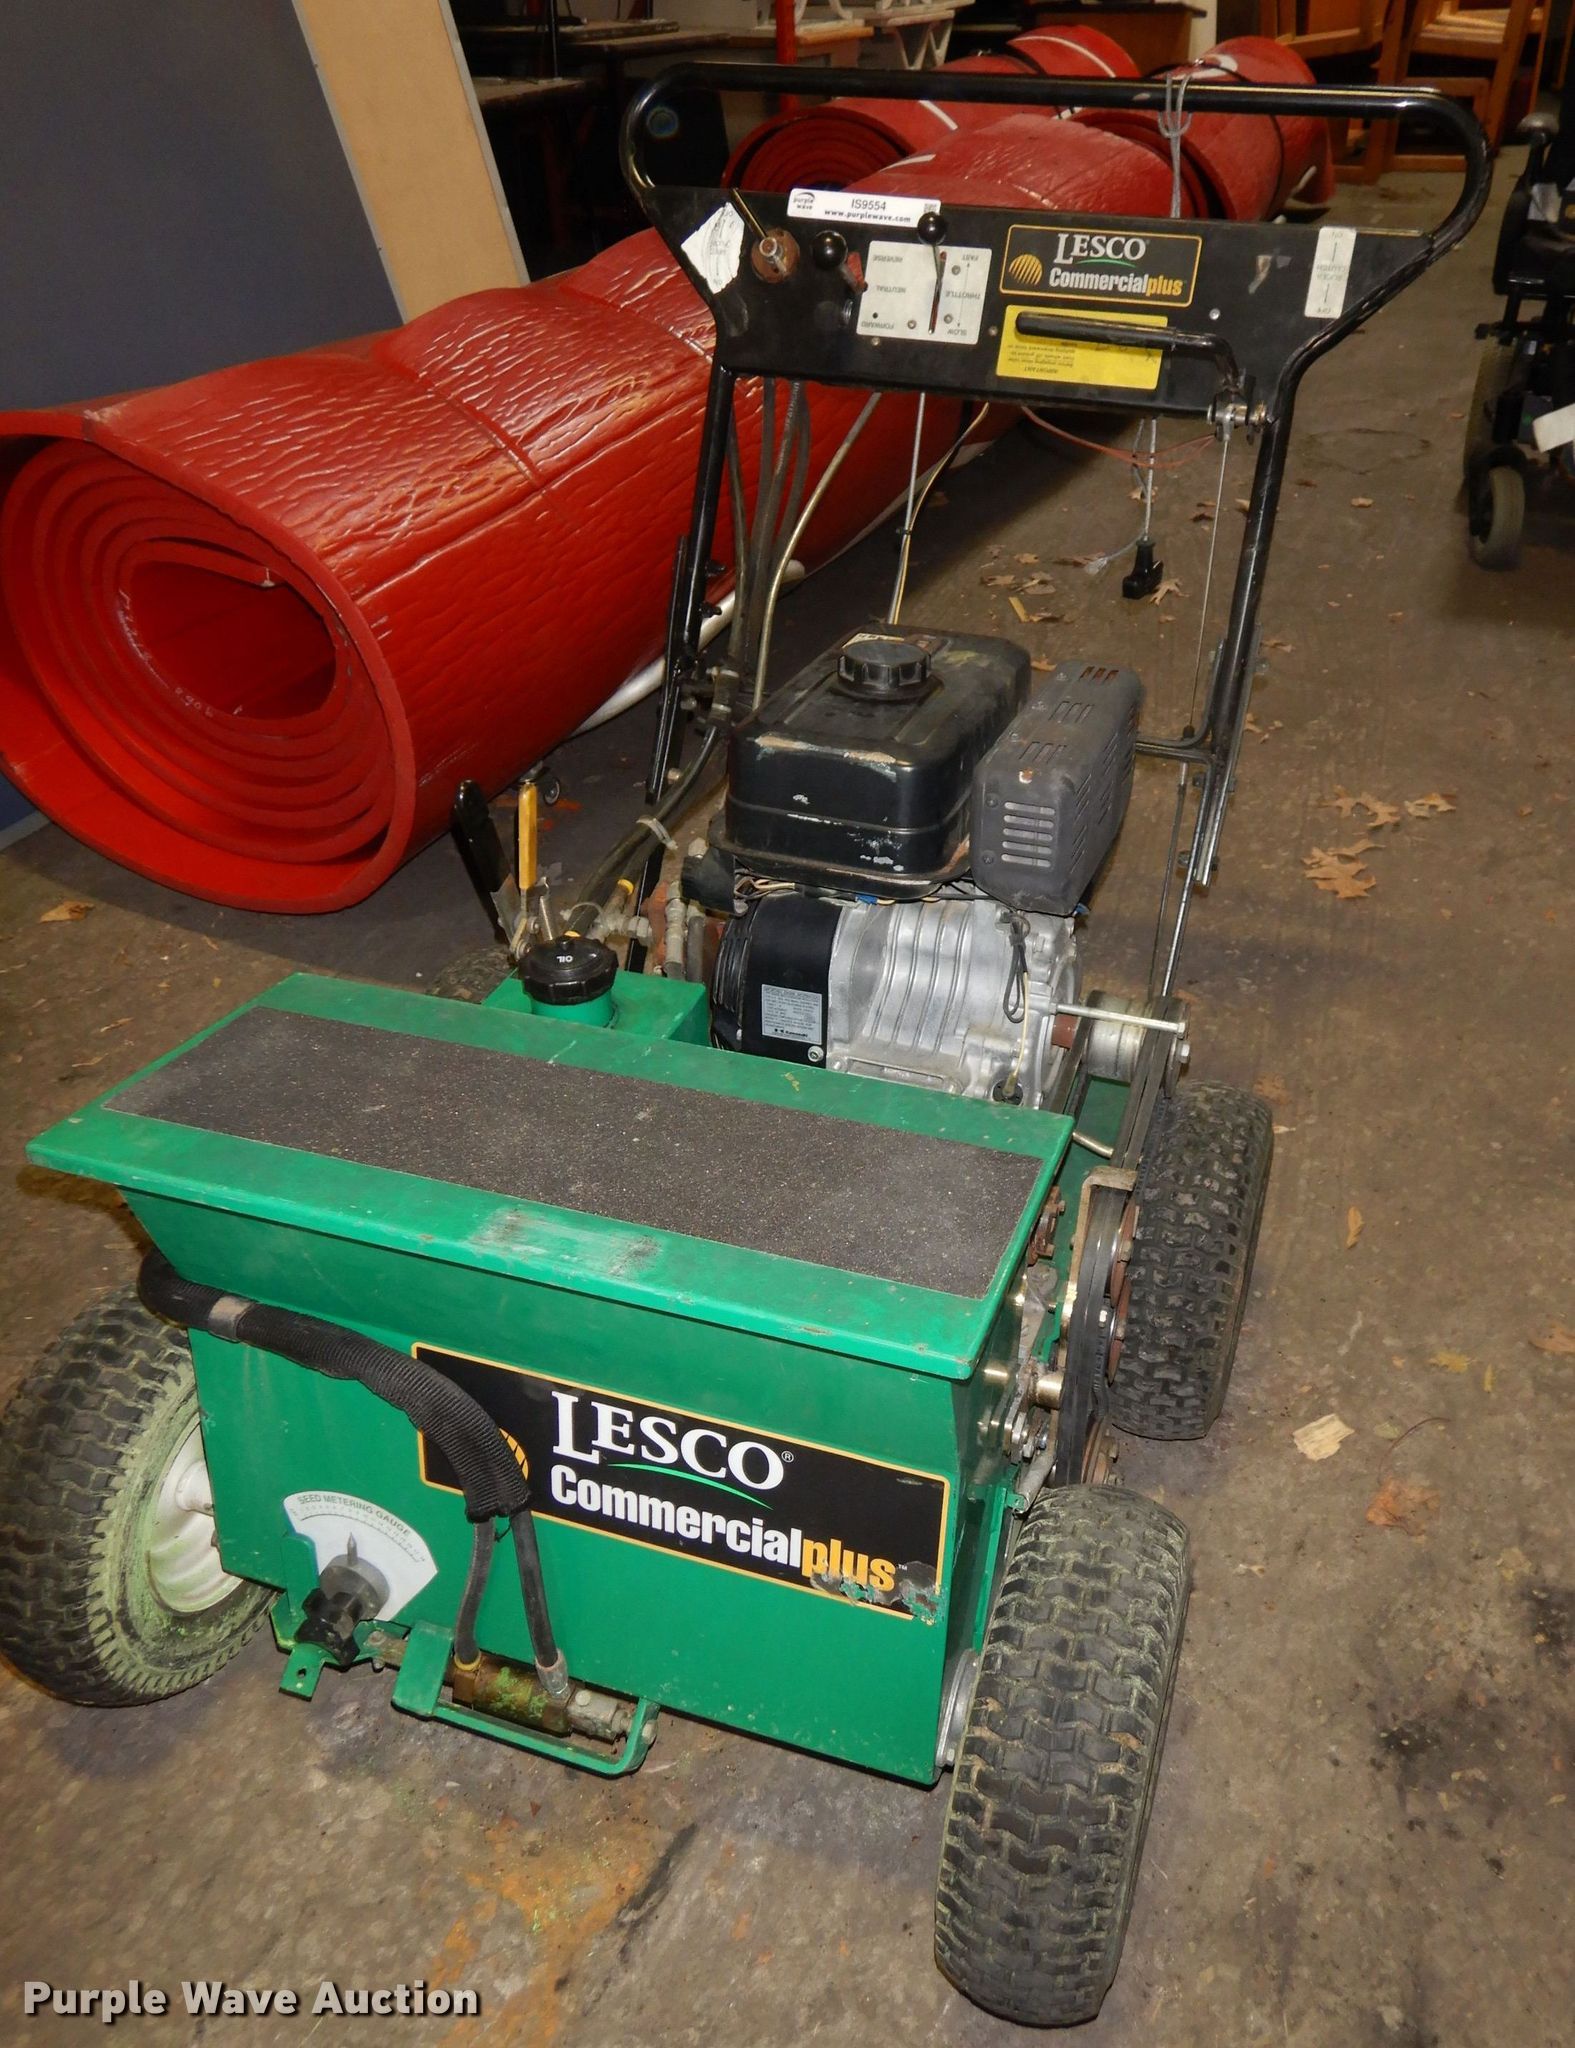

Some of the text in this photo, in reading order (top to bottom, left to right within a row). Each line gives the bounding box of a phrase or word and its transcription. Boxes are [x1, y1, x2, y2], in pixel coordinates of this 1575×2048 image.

[851, 199, 886, 211] IS9554
[824, 209, 911, 223] www.purplewave.com
[872, 254, 903, 263] REVERSE
[876, 285, 906, 294] NEUTRAL
[945, 290, 981, 300] THROTTLE
[861, 321, 895, 330] FORWARD
[947, 328, 968, 336] SLOW
[556, 955, 574, 963] OIL
[297, 1494, 411, 1537] SEED METERING GAUGE
